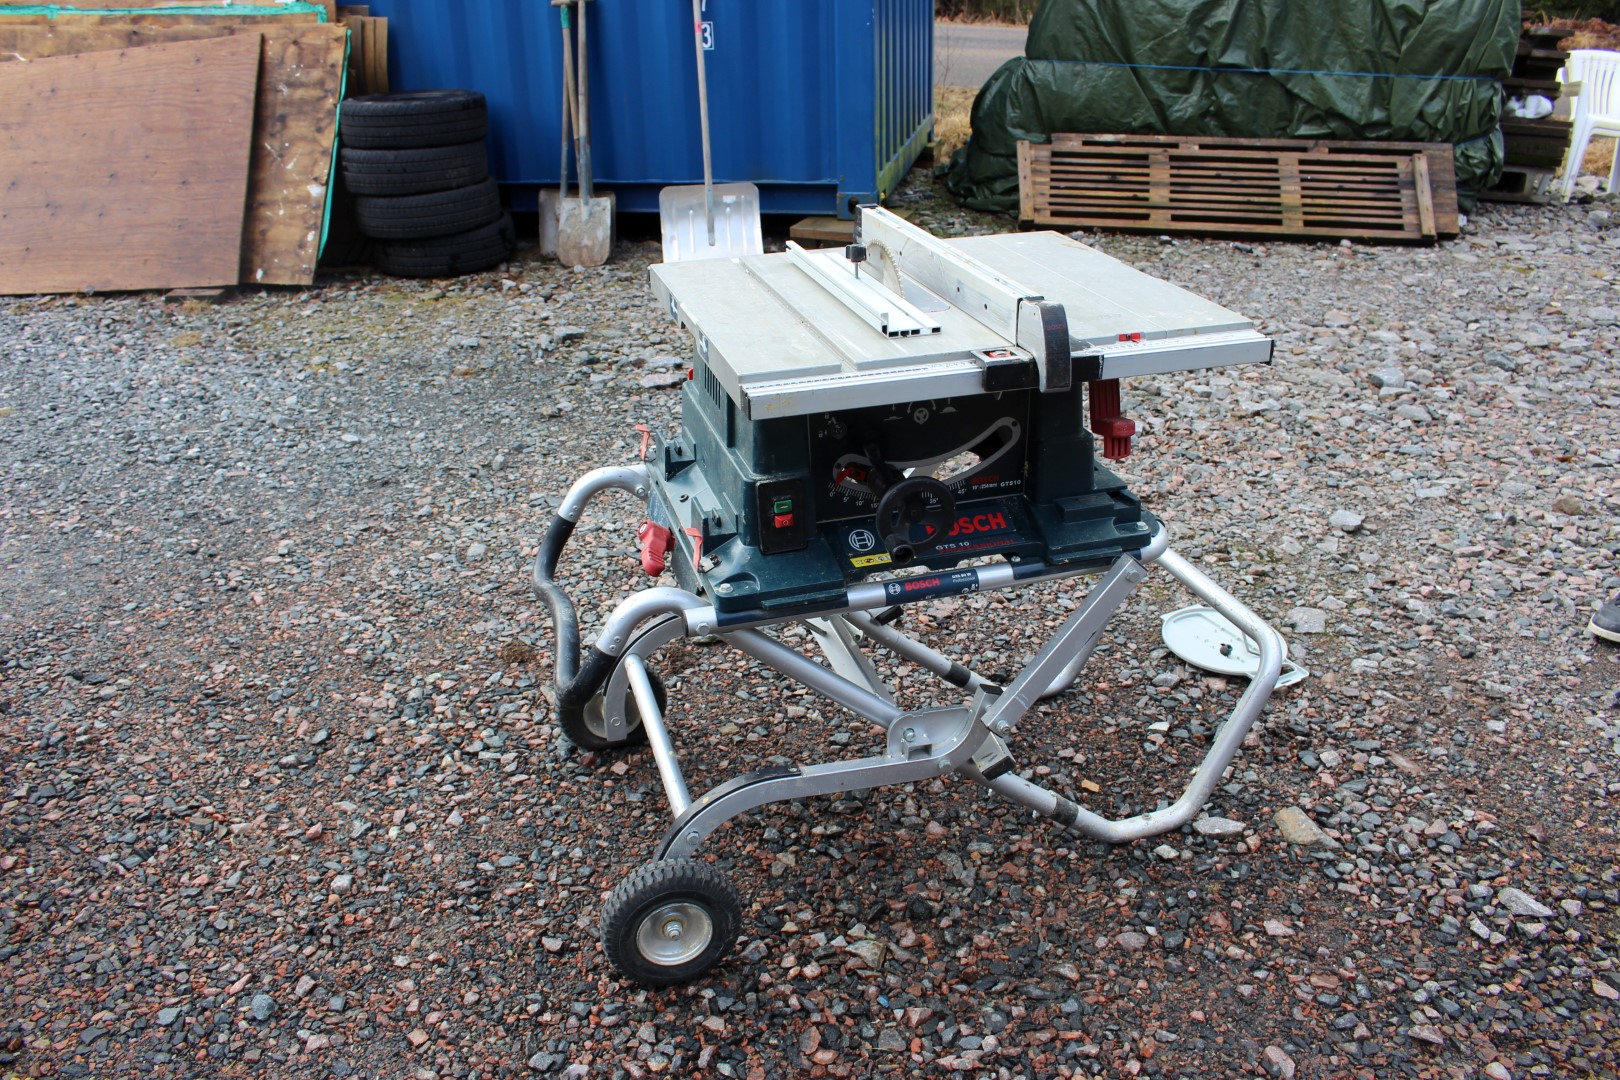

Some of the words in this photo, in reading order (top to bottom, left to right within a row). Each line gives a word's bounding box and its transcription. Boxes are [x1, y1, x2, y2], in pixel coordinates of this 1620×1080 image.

[701, 23, 712, 48] 3
[935, 543, 957, 551] GTS
[904, 577, 940, 592] BOSCH
